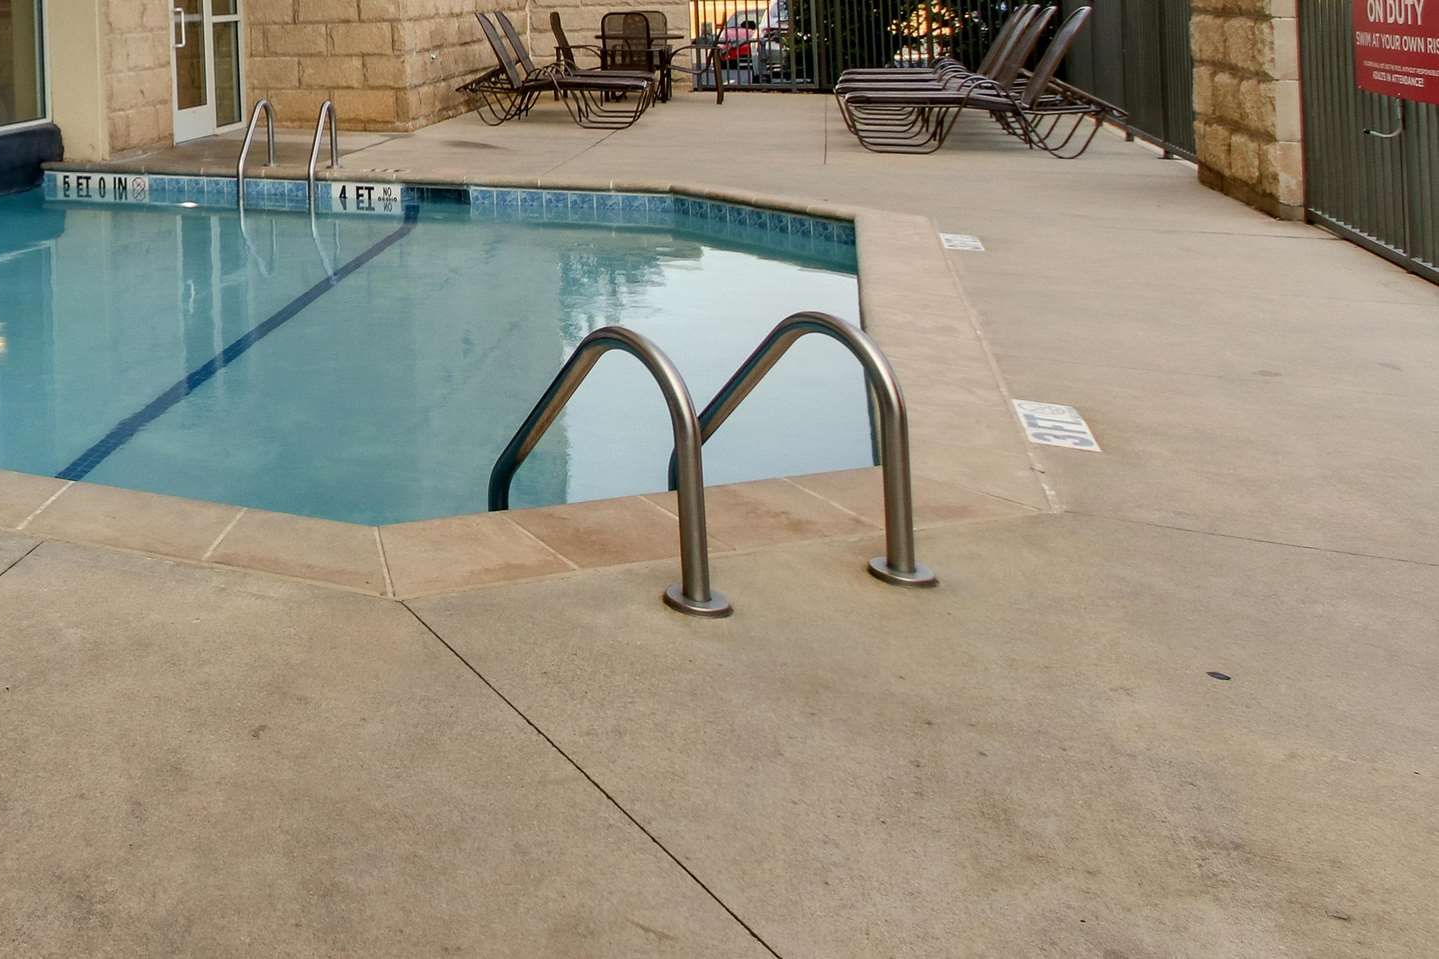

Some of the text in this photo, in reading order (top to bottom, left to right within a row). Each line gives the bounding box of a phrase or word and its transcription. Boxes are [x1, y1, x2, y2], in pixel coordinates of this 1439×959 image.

[1371, 33, 1380, 48] AT
[1380, 33, 1401, 51] YOUR
[1401, 35, 1425, 53] OWN
[339, 184, 347, 200] 4
